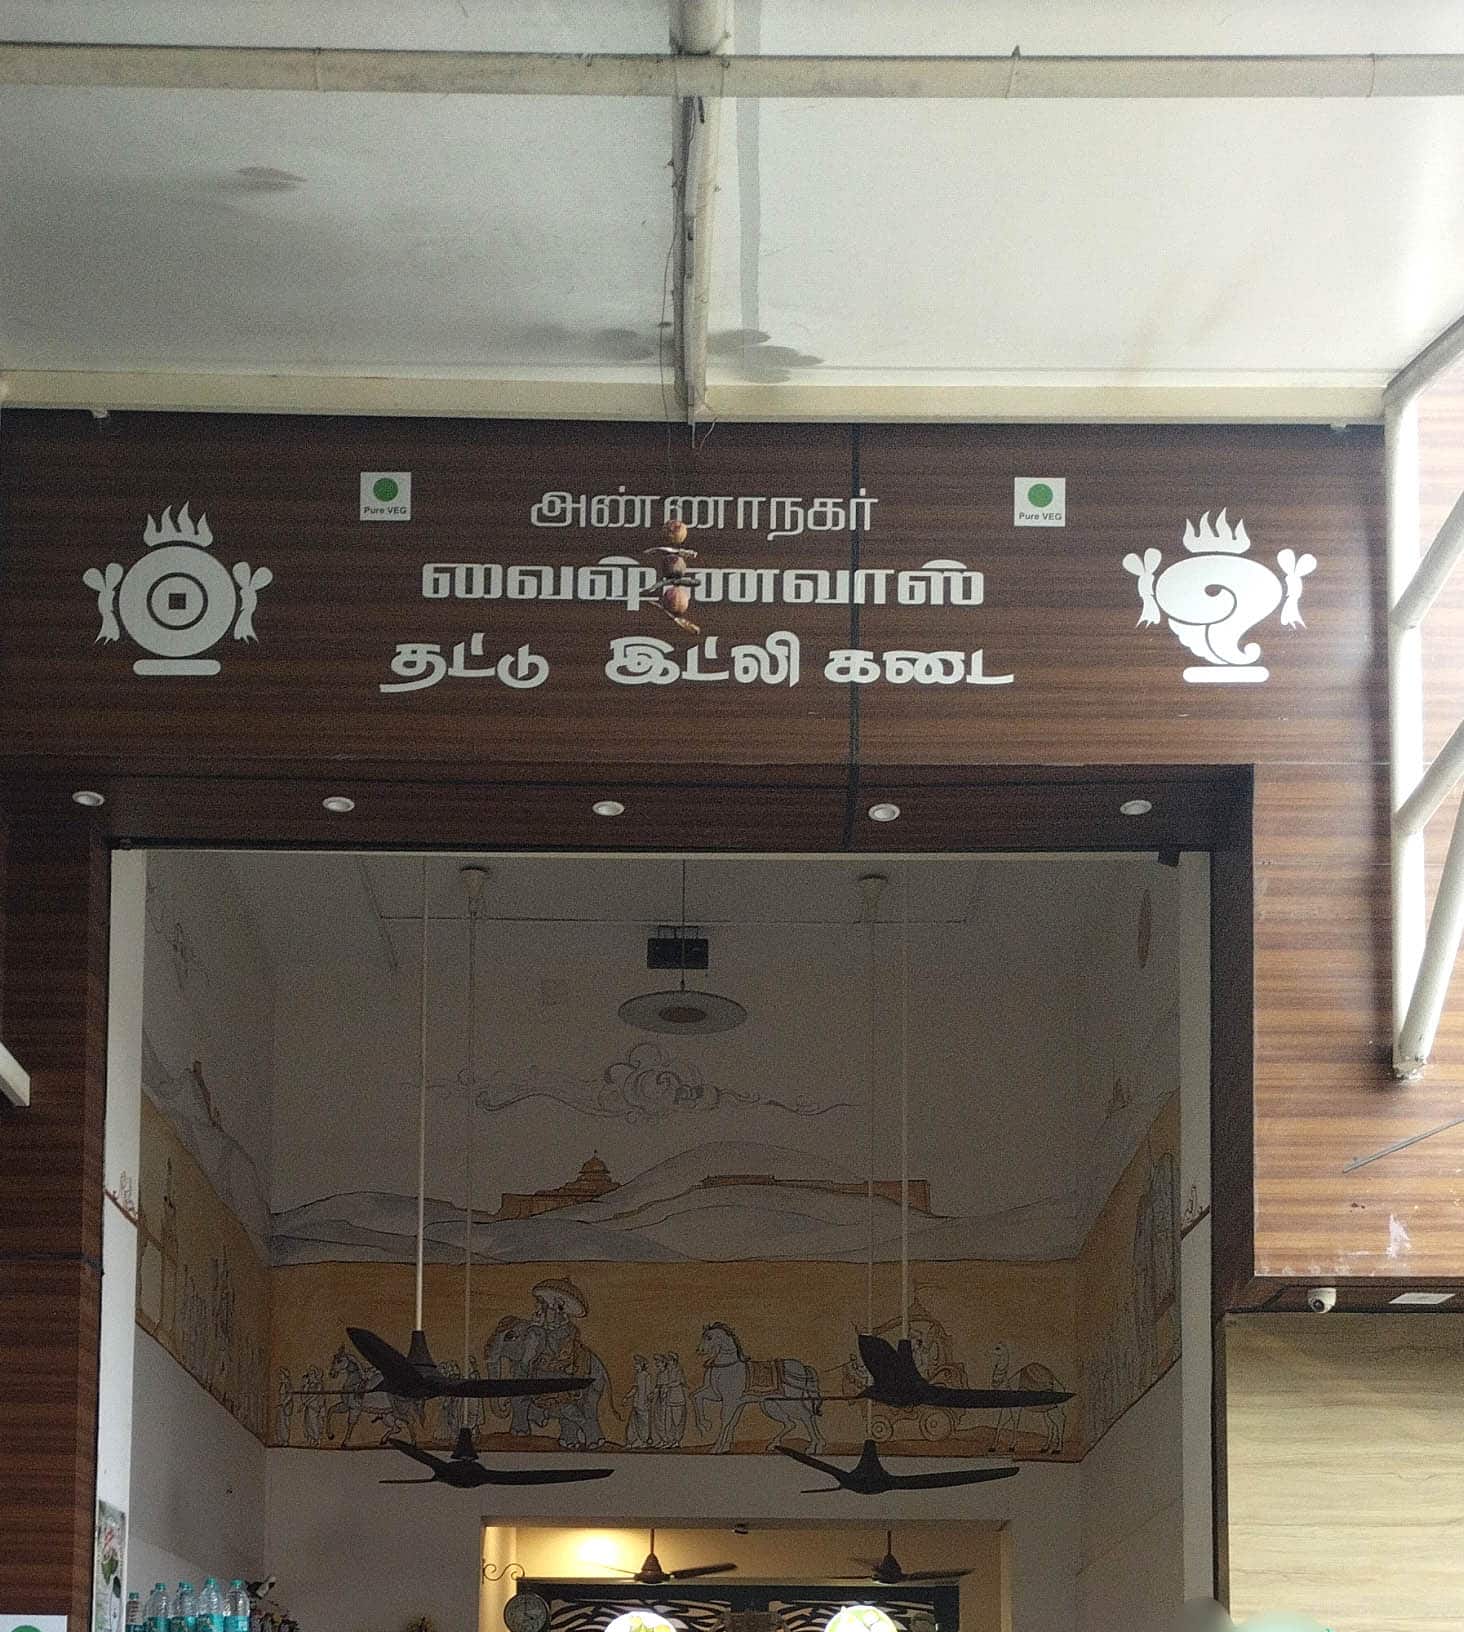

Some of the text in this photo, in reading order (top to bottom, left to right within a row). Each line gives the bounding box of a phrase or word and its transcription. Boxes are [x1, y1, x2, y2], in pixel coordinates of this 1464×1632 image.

[363, 506, 408, 514] Pure VEG
[531, 486, 879, 541] அண்ணாநகர்
[1019, 512, 1062, 520] Pure VEG
[379, 630, 1015, 693] தட்டு இட்லி கடை
